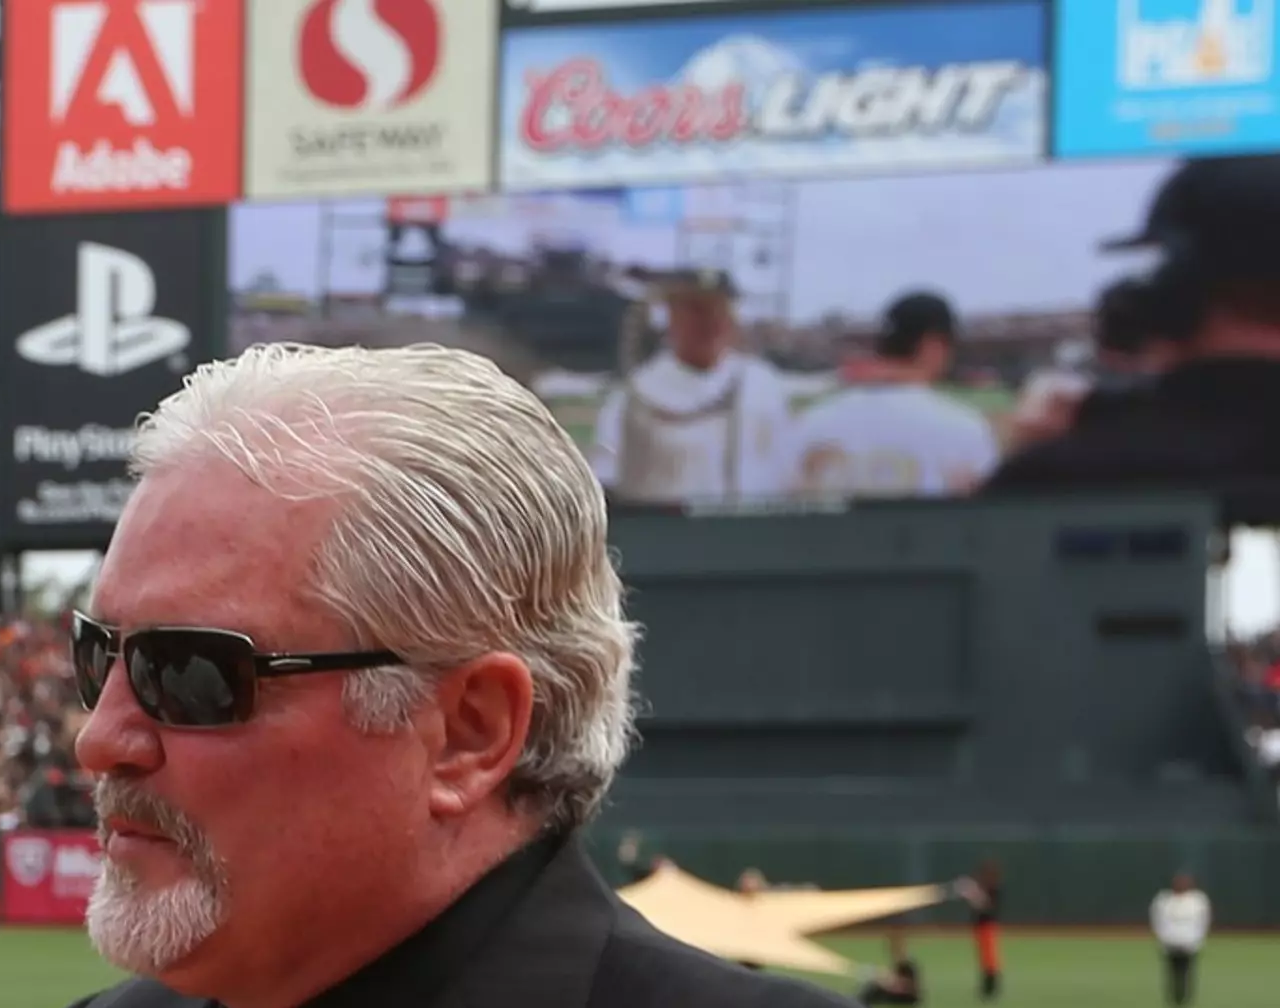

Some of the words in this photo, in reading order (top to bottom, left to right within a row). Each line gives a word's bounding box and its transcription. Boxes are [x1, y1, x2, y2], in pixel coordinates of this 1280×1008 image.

[519, 56, 746, 152] Coors
[753, 60, 1024, 139] LIGHT
[51, 136, 193, 196] Adobe
